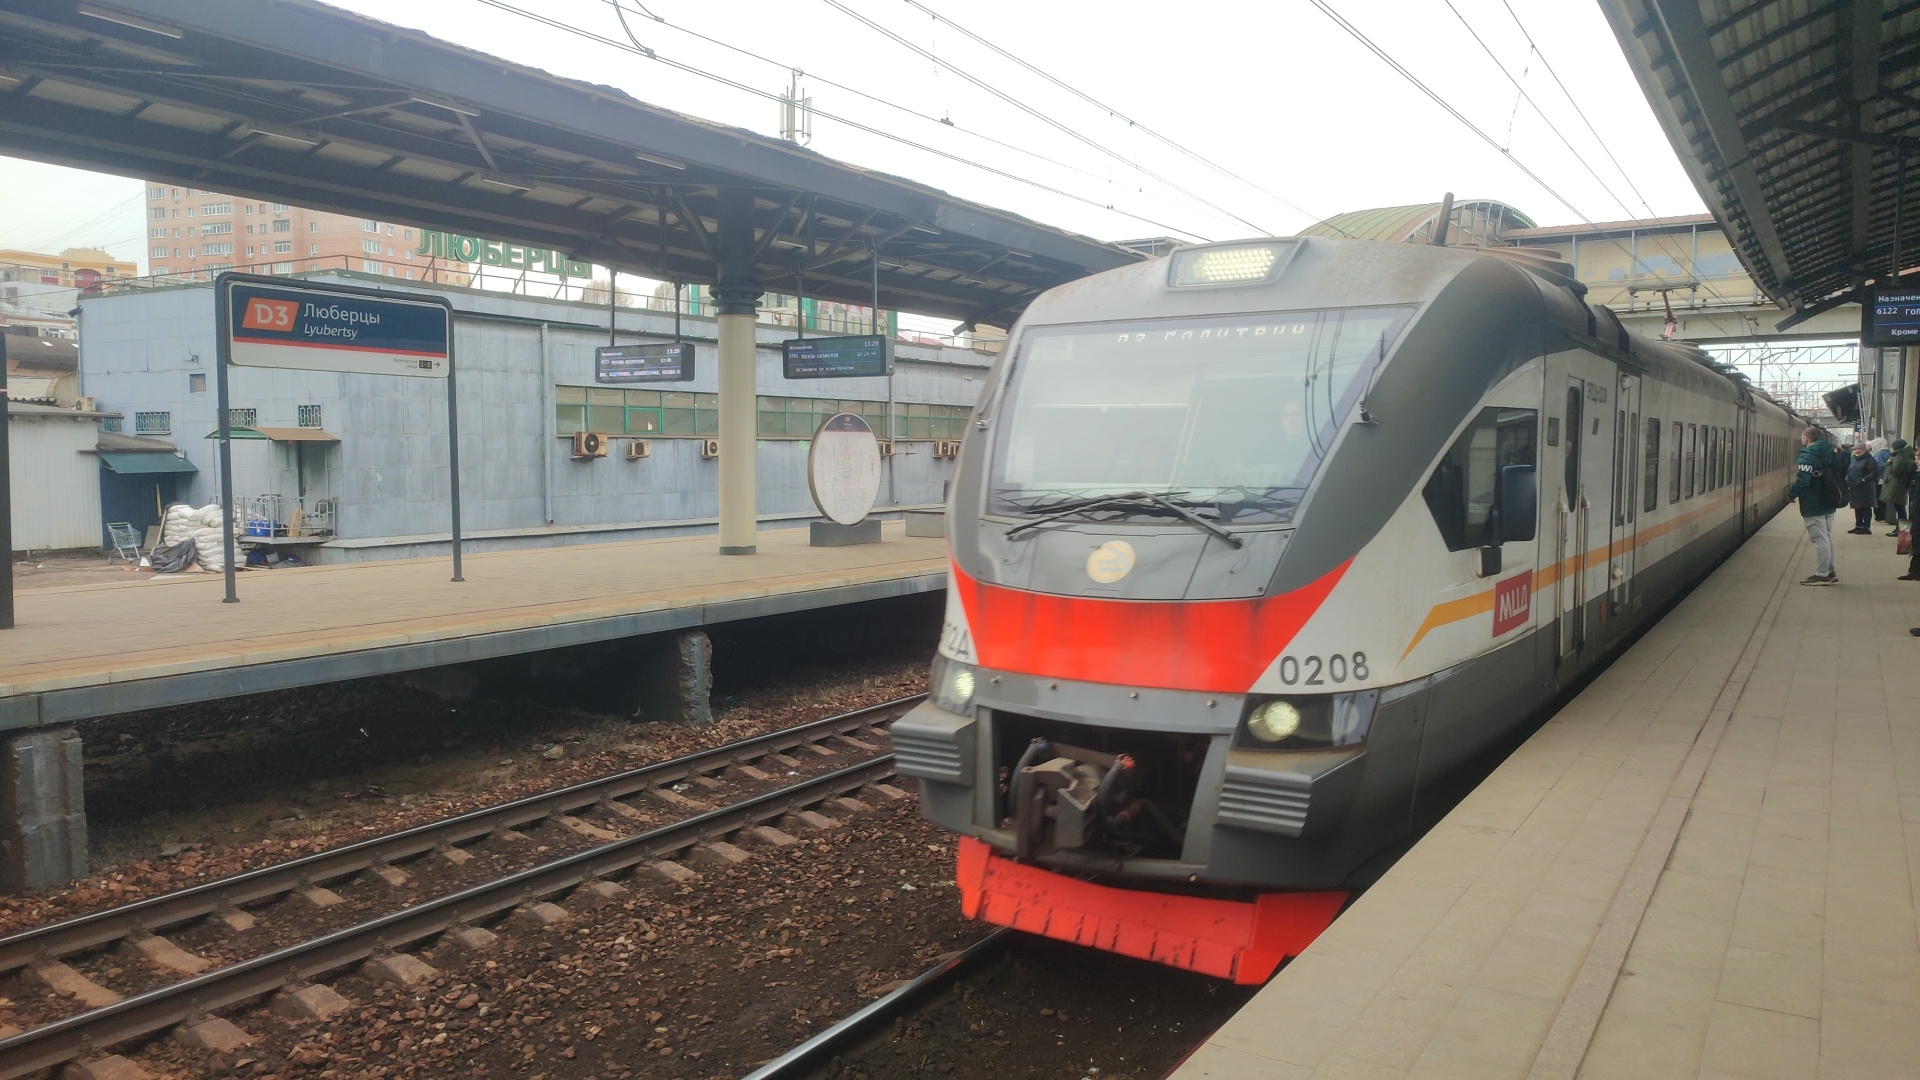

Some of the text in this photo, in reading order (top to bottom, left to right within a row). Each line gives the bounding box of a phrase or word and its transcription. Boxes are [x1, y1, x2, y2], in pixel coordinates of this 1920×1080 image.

[416, 229, 592, 281] ЛЮБЕРЦЫ
[254, 303, 289, 326] D3
[303, 303, 380, 325] Люберцы
[1876, 307, 1898, 315] 6122
[304, 323, 358, 340] Lyubertsy
[1499, 583, 1529, 623] МЦД
[1279, 650, 1370, 686] 0208
